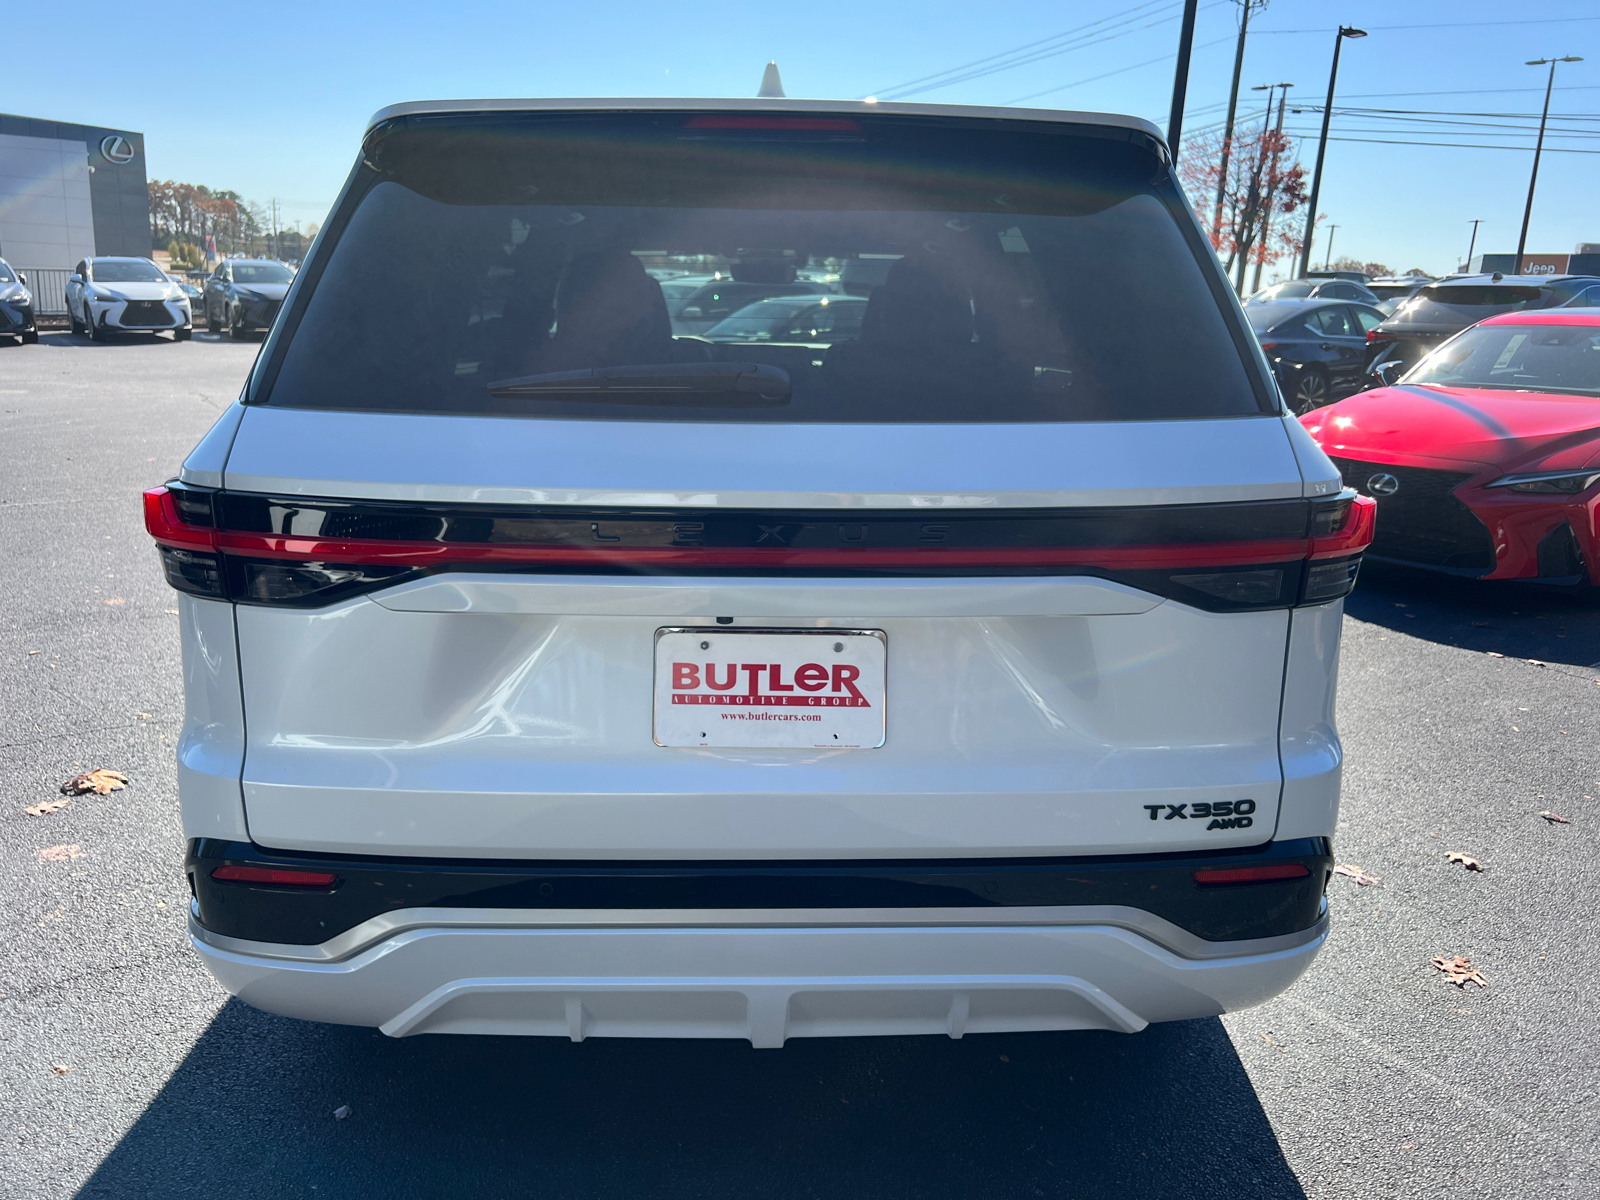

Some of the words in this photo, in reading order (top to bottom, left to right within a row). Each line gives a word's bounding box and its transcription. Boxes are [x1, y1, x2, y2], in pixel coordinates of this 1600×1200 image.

[1524, 261, 1556, 274] Jeep
[590, 522, 951, 543] LEXUS
[673, 695, 788, 705] AUTOMOTIVE
[808, 697, 864, 706] GROUP
[721, 711, 822, 722] www.butlercars.com
[1206, 816, 1253, 831] AWD
